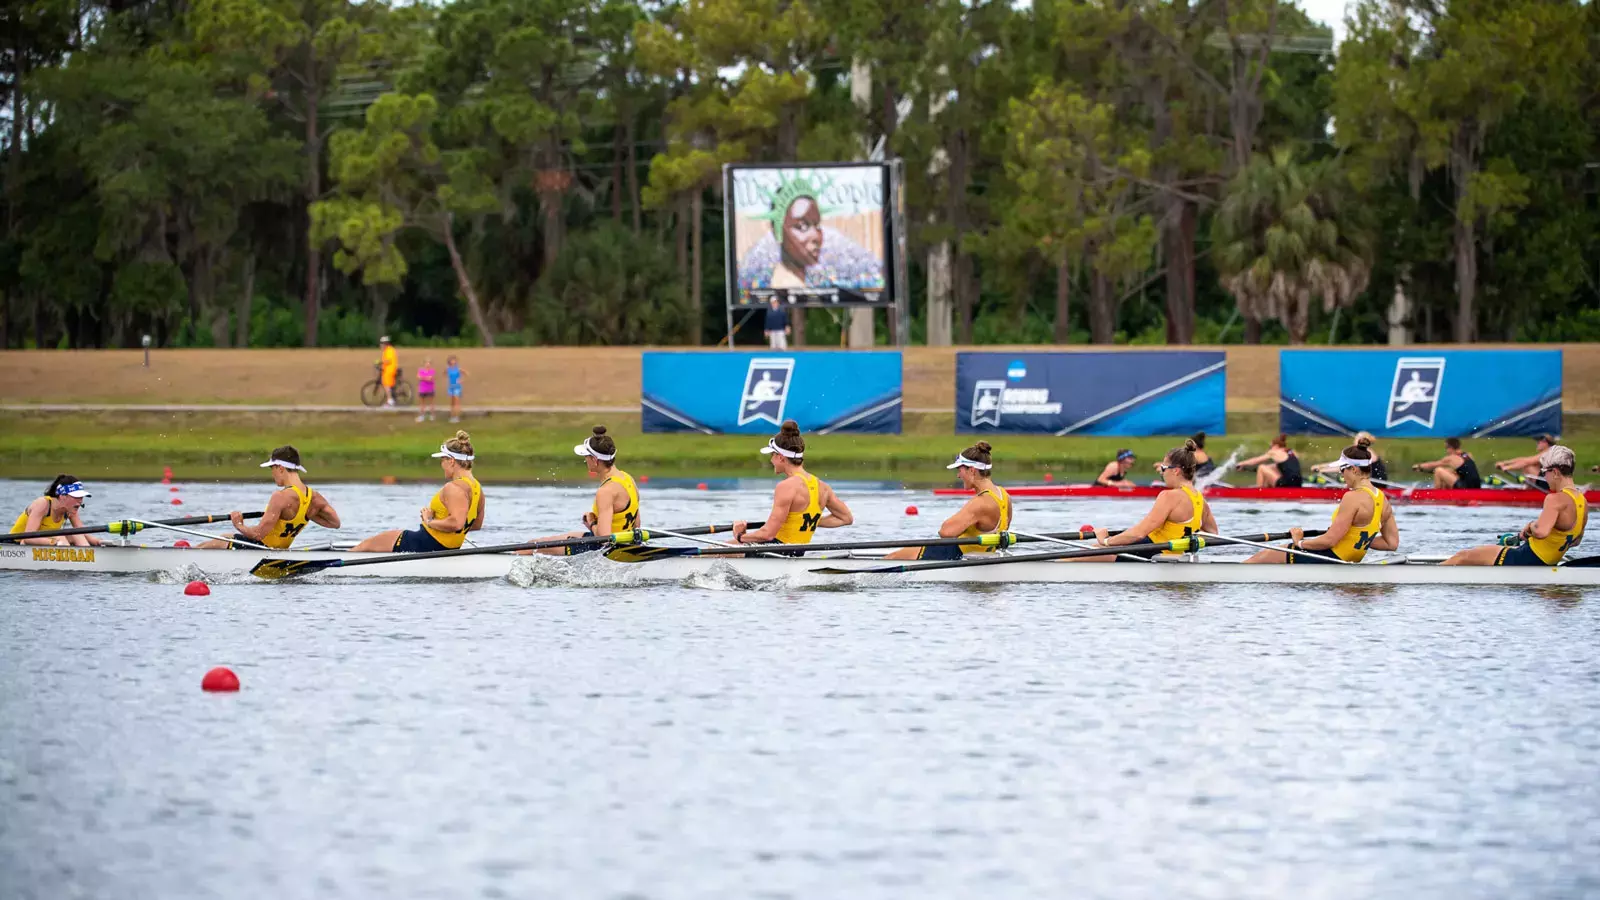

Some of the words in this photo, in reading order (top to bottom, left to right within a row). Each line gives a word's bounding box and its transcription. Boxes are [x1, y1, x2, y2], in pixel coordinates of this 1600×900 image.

[799, 513, 821, 531] M
[280, 523, 305, 538] M
[1354, 531, 1378, 550] M
[33, 548, 95, 562] MICHIGAN
